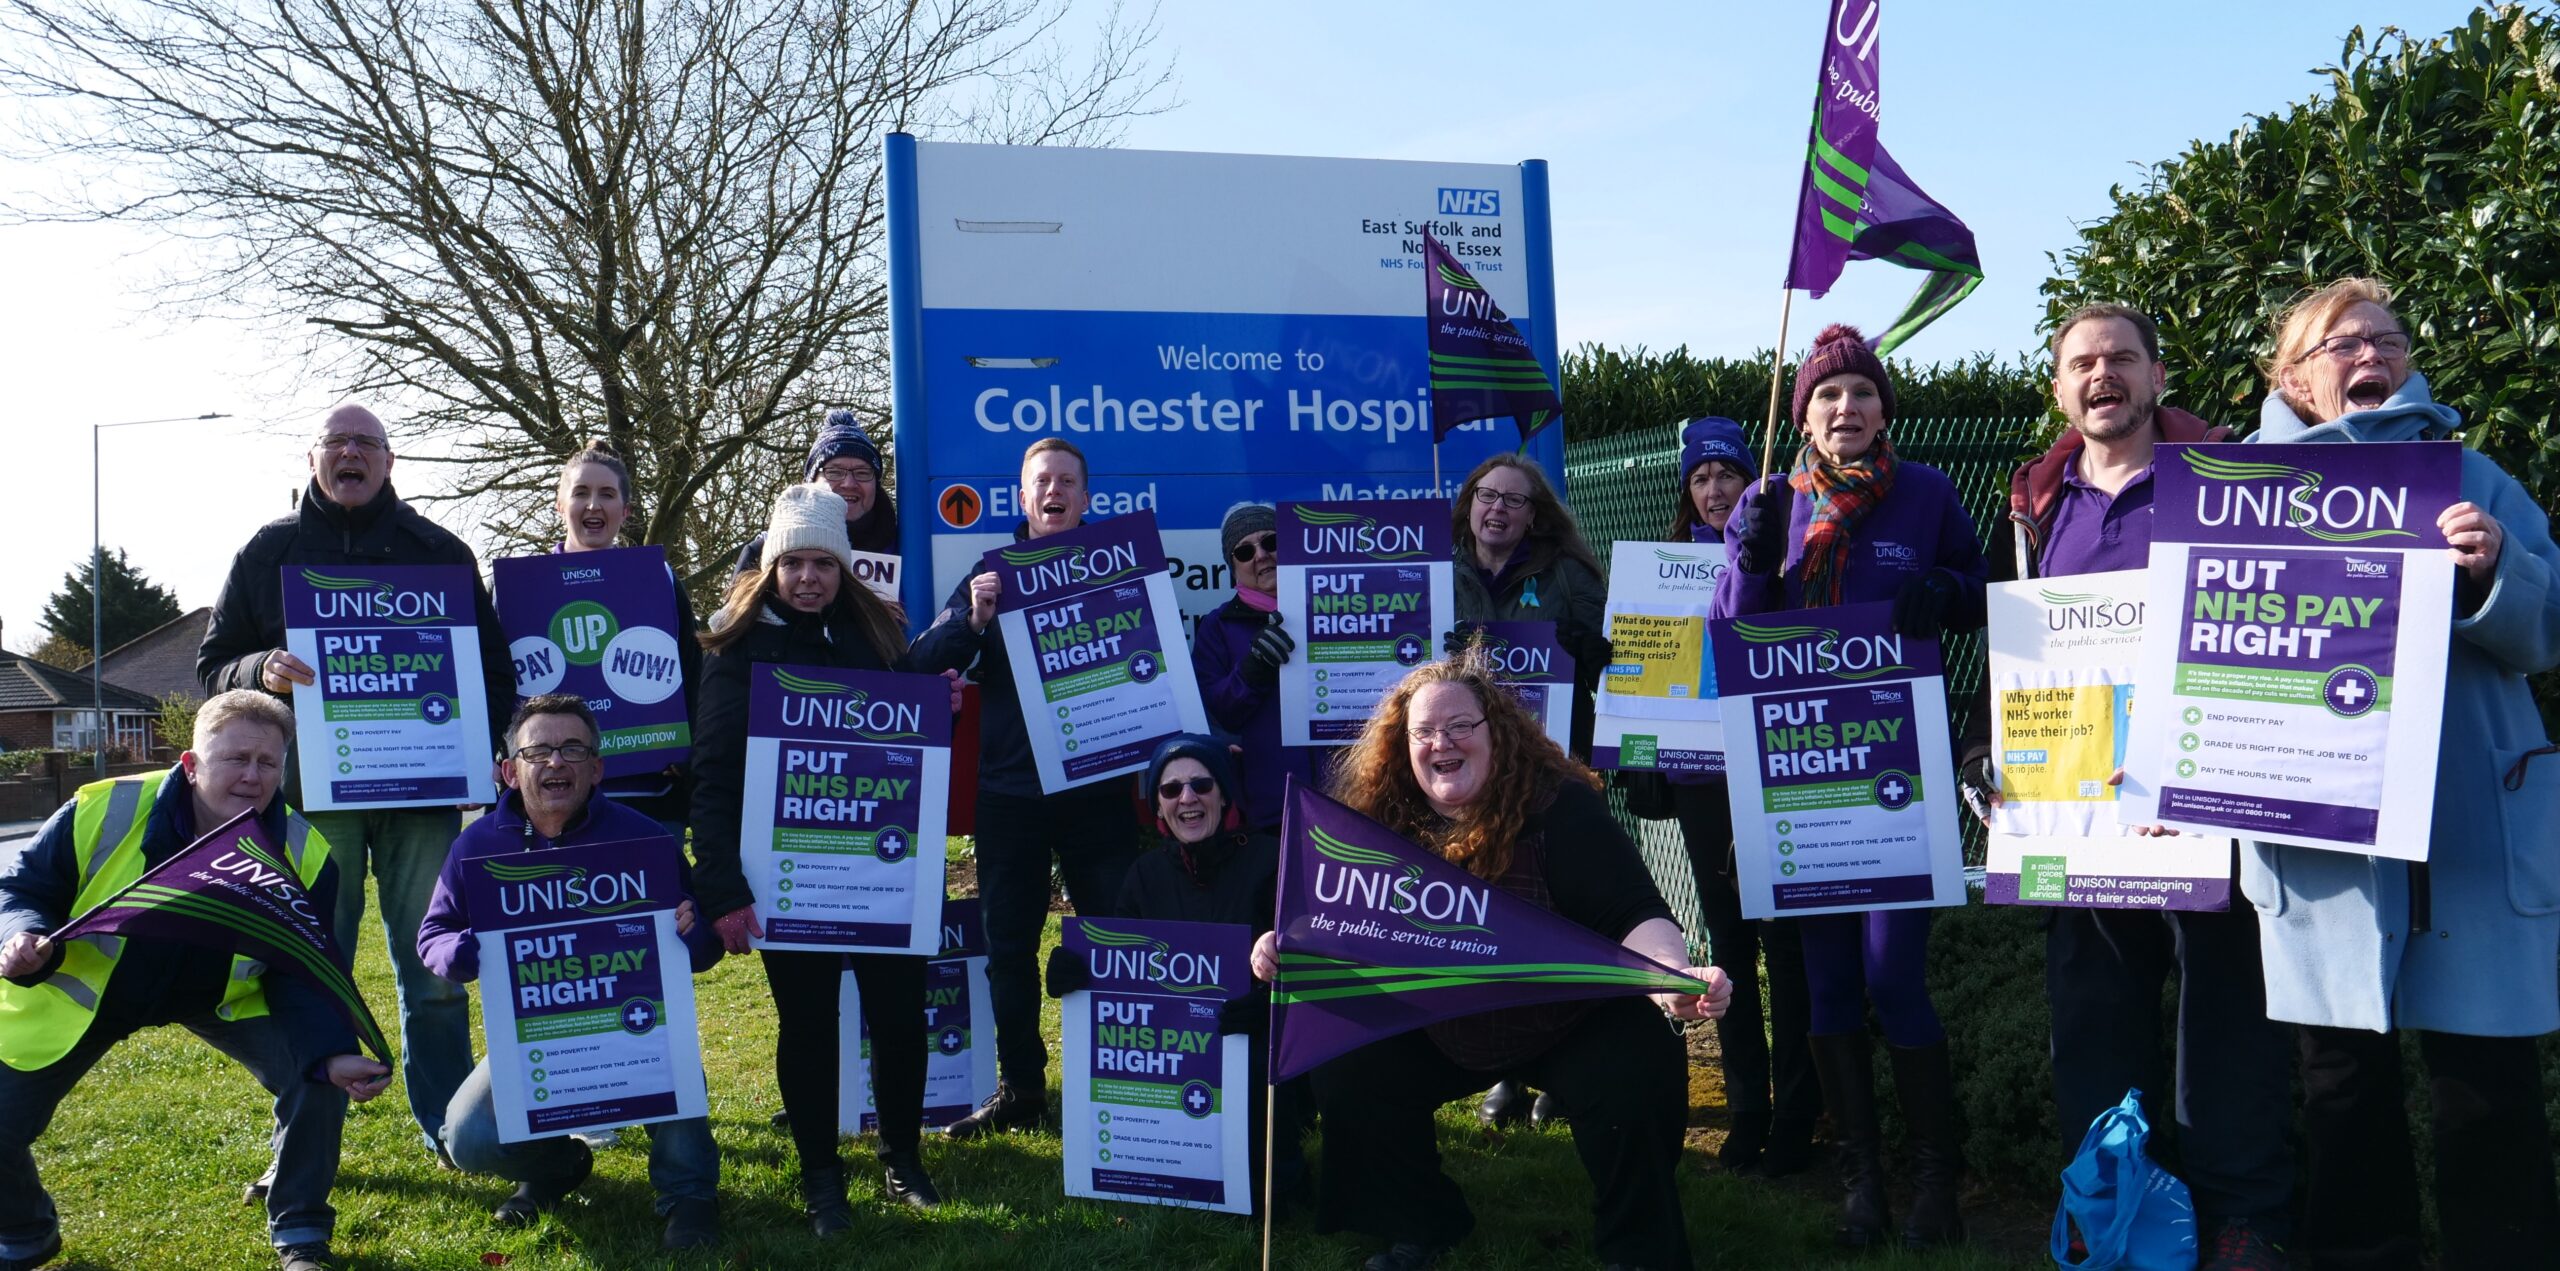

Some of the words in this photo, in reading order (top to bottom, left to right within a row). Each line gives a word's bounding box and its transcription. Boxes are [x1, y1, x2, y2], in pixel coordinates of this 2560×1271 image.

[1440, 190, 1496, 214] NHS
[1362, 220, 1397, 234] East
[1472, 223, 1501, 238] and
[1402, 240, 1449, 253] Noh
[1457, 242, 1502, 256] Essex
[1381, 259, 1403, 269] NHS
[1475, 261, 1502, 271] Trust
[1441, 323, 1456, 334] the
[1458, 327, 1491, 341] public
[1158, 345, 1282, 370] Welcome
[1295, 349, 1324, 371] to
[974, 385, 1263, 433] Colchester
[1705, 442, 1738, 455] UNISON
[2197, 485, 2407, 529] UNISON
[1304, 526, 1423, 553] UNISON
[562, 568, 600, 581] UNISON
[1016, 541, 1137, 596] UNISON
[2197, 558, 2286, 591] PUT
[2347, 562, 2387, 573] UNISON
[1312, 574, 1365, 594] PUT
[315, 592, 445, 618] UNISON
[1313, 594, 1367, 613] NHS
[1373, 592, 1421, 612] PAY
[2194, 590, 2287, 623] NHS
[2295, 595, 2384, 629] PAY
[1032, 602, 1084, 633] PUT
[1313, 614, 1395, 634] RIGHT
[1614, 616, 1637, 624] What
[1640, 617, 1651, 625] do
[1654, 618, 1671, 627] you
[1673, 618, 1688, 626] call
[563, 614, 607, 653] UP
[1038, 622, 1093, 653] NHS
[1096, 608, 1143, 638] PAY
[1620, 629, 1644, 638] wage
[1646, 629, 1661, 637] cut
[2190, 622, 2331, 659] RIGHT
[324, 636, 382, 654] PUT
[1629, 640, 1661, 648] middle
[2051, 638, 2064, 648] the
[2067, 636, 2097, 649] public
[326, 654, 387, 673] NHS
[393, 653, 444, 672] PAY
[1042, 635, 1122, 673] RIGHT
[1648, 652, 1676, 660] crisis?
[1749, 634, 1902, 680] UNISON
[512, 648, 554, 686] PAY
[612, 648, 676, 684] NOW!
[1608, 665, 1624, 673] NHS
[1626, 665, 1641, 674] PAY
[328, 673, 417, 693] RIGHT
[2006, 692, 2031, 705] Why
[2035, 690, 2052, 702] did
[2056, 691, 2074, 701] the
[782, 696, 920, 733] UNISON
[1763, 699, 1828, 727] PUT
[2007, 709, 2030, 721] NHS
[2033, 709, 2072, 719] worker
[2227, 715, 2266, 724] POVERTY
[1765, 725, 1835, 752] NHS
[1842, 717, 1904, 745] PAY
[2008, 727, 2037, 738] leave
[2040, 725, 2067, 737] their
[2070, 724, 2094, 739] job?
[1659, 751, 1696, 759] UNISON
[2204, 740, 2233, 748] GRADE
[2250, 744, 2275, 752] RIGHT
[786, 750, 848, 774] PUT
[1658, 761, 1669, 769] for
[1681, 762, 1702, 770] fairer
[1768, 746, 1870, 777] RIGHT
[2007, 752, 2025, 762] NHS
[2027, 752, 2044, 761] PAY
[2007, 766, 2014, 774] is
[2016, 766, 2025, 774] no
[2027, 765, 2047, 775] joke.
[2219, 768, 2234, 776] THE
[2237, 770, 2266, 778] HOURS
[2286, 775, 2312, 784] WORK
[785, 774, 848, 798] NHS
[855, 778, 911, 800] PAY
[783, 797, 878, 822] RIGHT
[2192, 795, 2221, 803] UNISON?
[2038, 863, 2064, 871] million
[2038, 870, 2063, 878] voices
[500, 870, 646, 916] UNISON
[1315, 863, 1489, 926] UNISON
[2037, 883, 2061, 893] public
[2069, 877, 2116, 889] UNISON
[2119, 880, 2192, 893] campaigning
[2068, 892, 2082, 903] for
[2086, 894, 2093, 902] a
[2096, 892, 2123, 904] fairer
[2126, 894, 2168, 907] society
[189, 872, 213, 880] the
[208, 878, 253, 896] public
[292, 922, 324, 949] union
[1311, 914, 1335, 931] the
[1338, 922, 1387, 941] public
[1391, 930, 1446, 948] service
[1451, 939, 1498, 957] union
[514, 933, 577, 962] PUT
[517, 956, 584, 985] NHS
[589, 948, 647, 977] PAY
[1091, 949, 1220, 985] UNISON
[520, 976, 618, 1009] RIGHT
[1098, 1001, 1153, 1025] PUT
[1099, 1025, 1156, 1049] NHS
[1162, 1029, 1213, 1053] PAY
[1098, 1048, 1183, 1075] RIGHT
